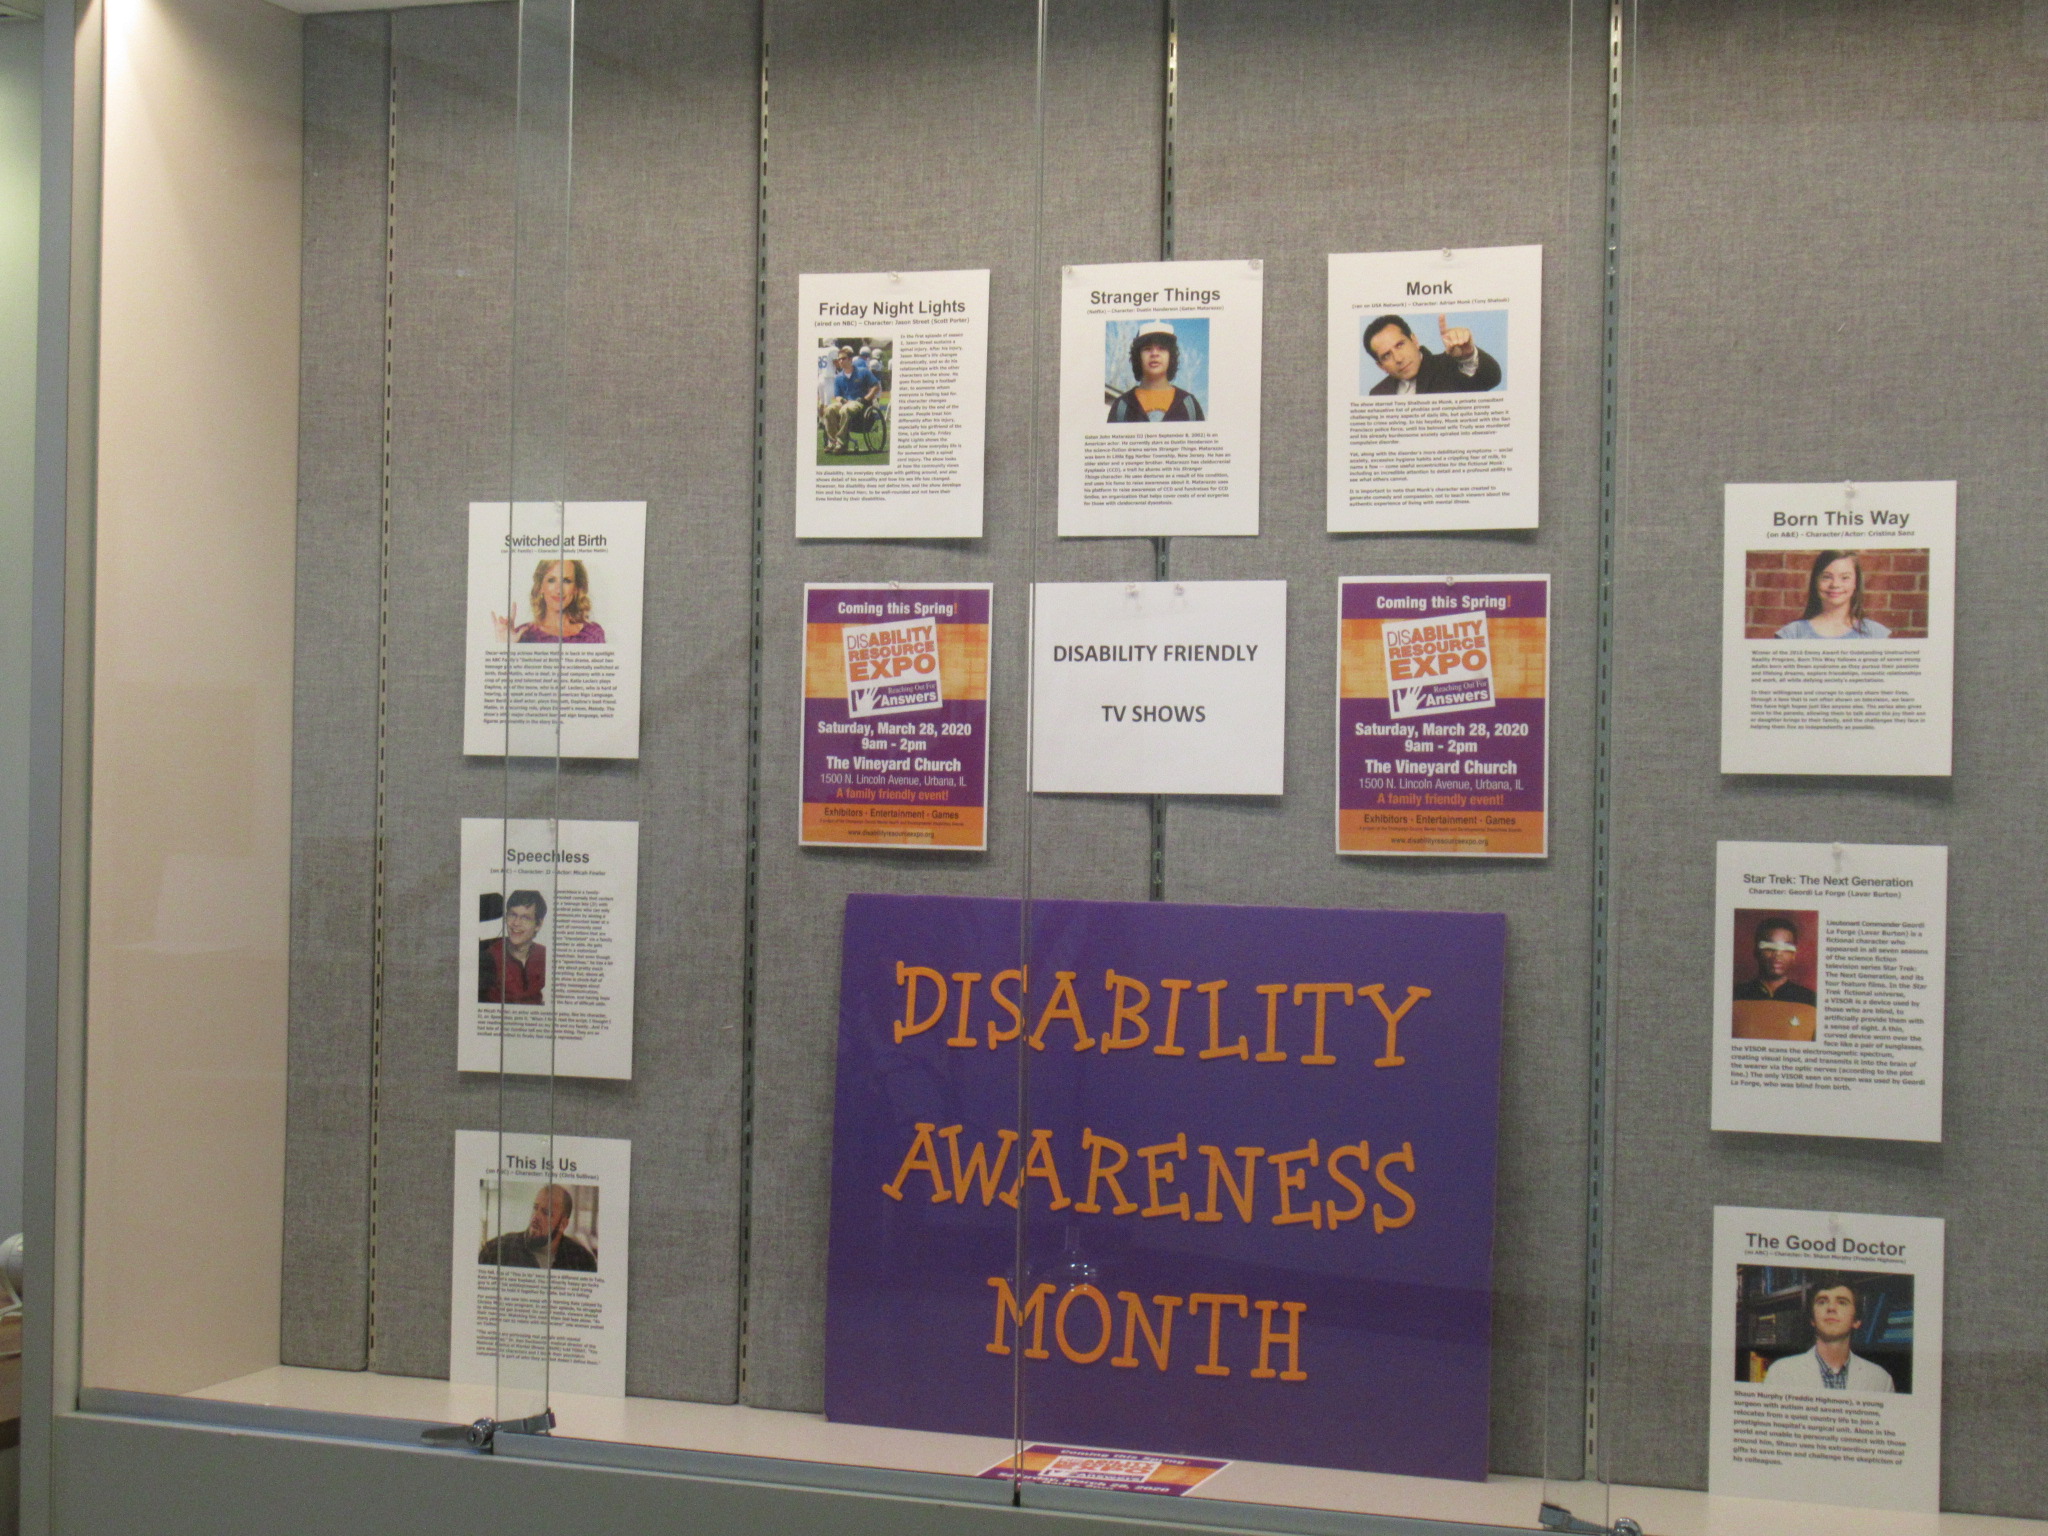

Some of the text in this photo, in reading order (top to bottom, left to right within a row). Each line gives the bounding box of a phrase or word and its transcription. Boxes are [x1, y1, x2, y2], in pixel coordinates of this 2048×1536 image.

[1406, 280, 1454, 297] Monk
[1090, 288, 1221, 307] Stranger Things
[819, 299, 967, 319] Friday Night Lights
[814, 319, 832, 328] (aired
[843, 319, 858, 328] NBC)
[864, 318, 894, 327] Character:
[895, 318, 912, 326] Jason
[913, 317, 931, 326] Street
[932, 317, 949, 327] (Scott
[950, 316, 970, 326] Porter)
[1773, 510, 1911, 529] Born This Way
[505, 533, 607, 548] Switched at Birth
[1767, 530, 1780, 539] (on
[1782, 530, 1799, 538] A&E)
[1868, 529, 1896, 537] Cristina
[837, 601, 958, 618] Coming this Spring!
[1376, 595, 1511, 611] Coming this Spring!
[847, 625, 933, 650] DISABILITY
[1386, 619, 1483, 647] DISABILITY
[848, 641, 935, 662] RESOURCE
[1052, 644, 1259, 662] DISABILITY FRIENDLY
[1388, 635, 1486, 659] RESOURCE
[849, 653, 936, 682] EXPO
[1390, 650, 1488, 681] EXPO
[887, 684, 914, 694] Reaching
[915, 683, 926, 691] Out
[1433, 679, 1488, 694] Reaching Out For
[880, 691, 937, 707] Answers
[1425, 690, 1489, 707] Answers
[1101, 705, 1206, 723] TV SHOWS
[817, 721, 972, 738] Saturday, March 28, 2020
[1355, 722, 1529, 739] Saturday, March 28, 2020
[862, 737, 888, 750] 9am
[900, 738, 927, 753] 2pm
[1404, 739, 1434, 753] 9am
[1447, 739, 1478, 755] 2pm
[826, 755, 962, 774] The Vineyard Church
[1365, 758, 1518, 777] The Vineyard Church
[820, 773, 967, 788] 1500 N. Lincoln Avenue, Urbana, IL
[1359, 778, 1524, 792] 1500 N. Lincoln Avenue, Urbana, IL
[836, 787, 949, 803] A family friendly event!
[1376, 792, 1505, 808] A family friendly event!
[824, 807, 959, 820] Exhibitors Entertainment Games
[1363, 813, 1517, 826] Exhibitors Entertainment Games
[506, 848, 591, 866] Speechless
[1743, 873, 1914, 889] Star Trek: The Next Generation
[1749, 887, 1787, 896] Character:
[1789, 888, 1814, 897] Geordi
[1815, 889, 1824, 897] La
[1825, 889, 1846, 899] Forge
[1873, 890, 1902, 899] Burton)
[894, 961, 1431, 1067] DISABILITY
[506, 1155, 578, 1172] This Is Us
[882, 1122, 1416, 1234] AWARENESS
[1745, 1232, 1780, 1250] The
[1786, 1235, 1837, 1253] Good
[1842, 1238, 1907, 1257] Doctor
[986, 1277, 1307, 1381] MONTH
[1060, 1449, 1110, 1459] Coming
[1063, 1478, 1107, 1487] March
[1133, 1485, 1171, 1493] 2020
